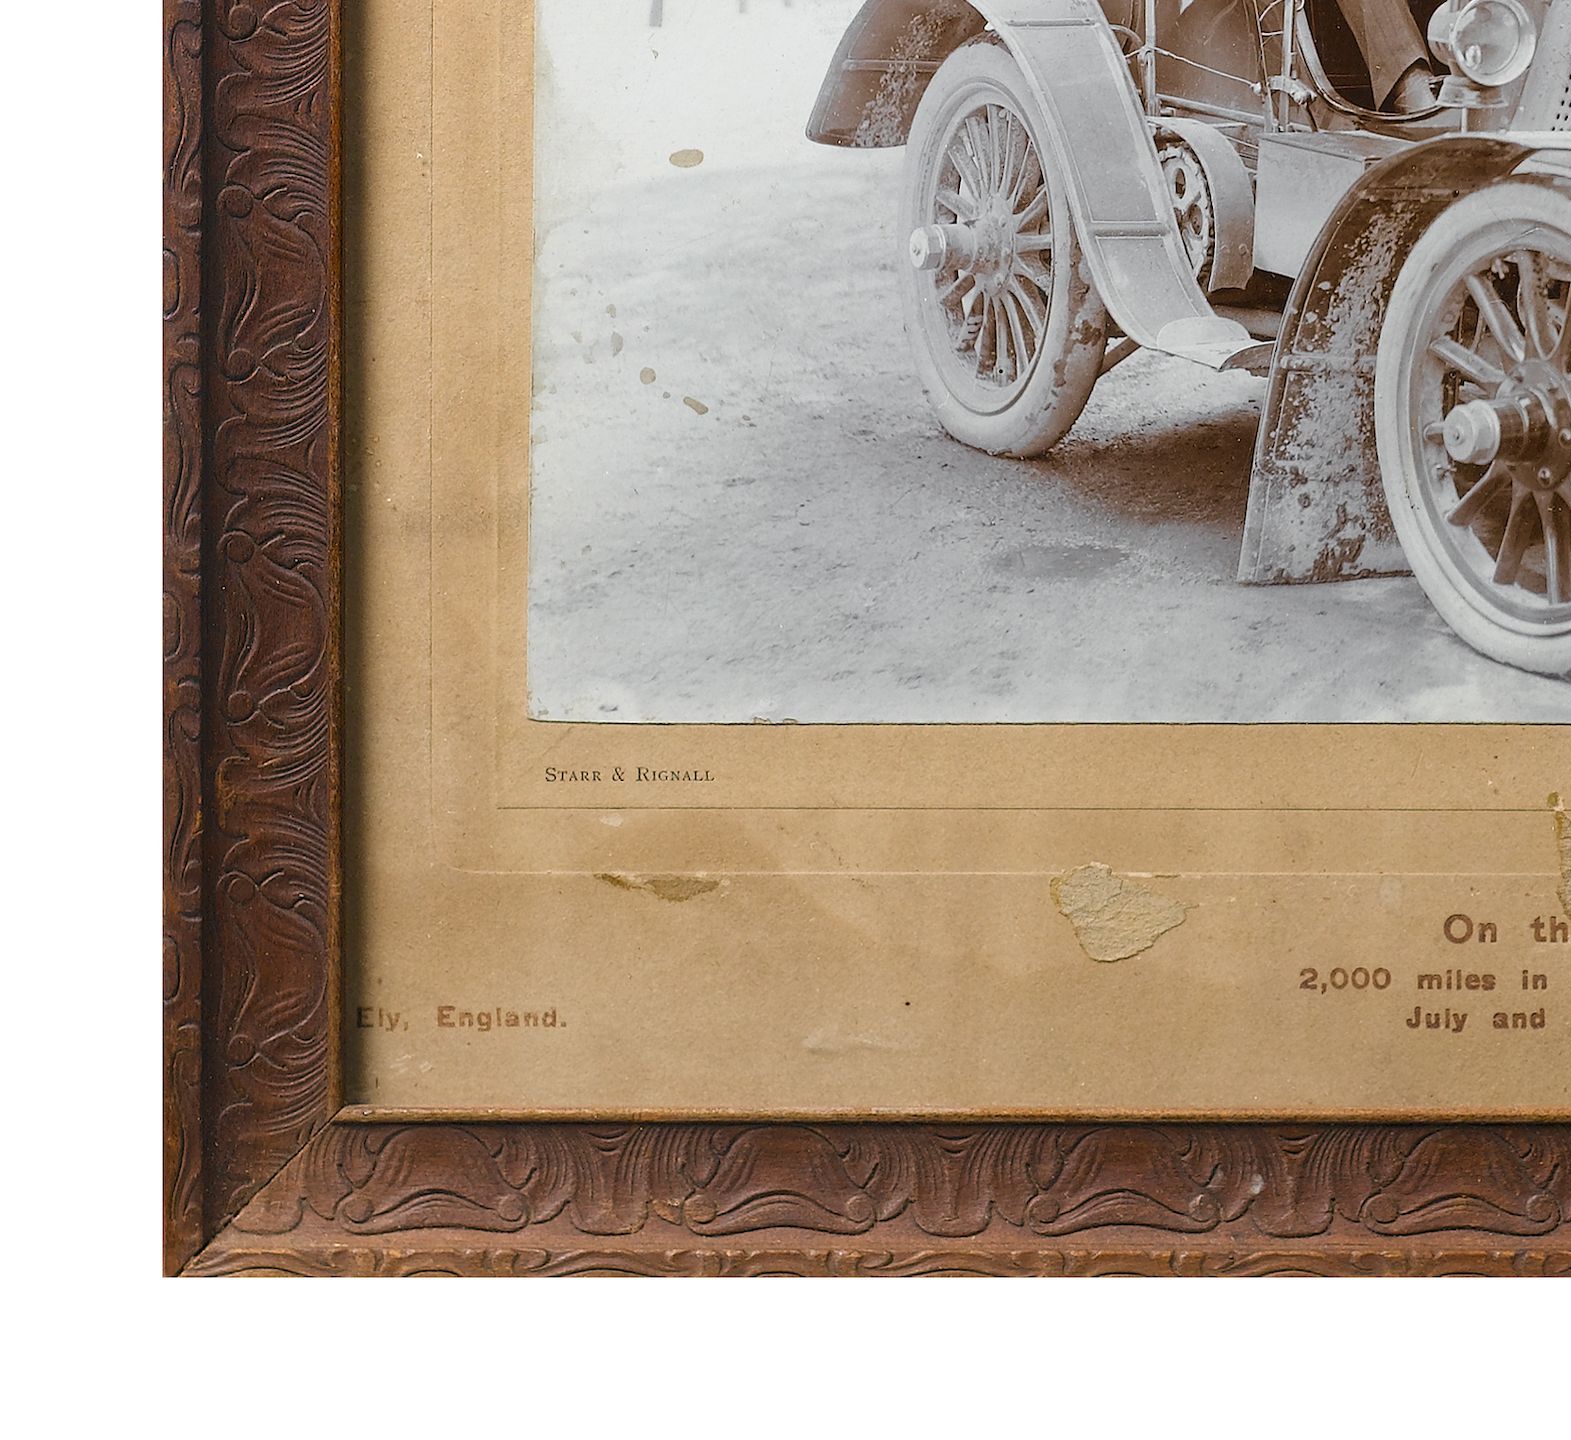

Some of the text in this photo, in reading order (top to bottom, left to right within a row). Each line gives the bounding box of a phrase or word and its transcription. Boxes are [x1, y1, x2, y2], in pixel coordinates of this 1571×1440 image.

[545, 766, 716, 783] STARR & RIGNALL
[1443, 913, 1498, 945] On
[1299, 966, 1392, 995] 2,000
[1417, 968, 1497, 992] miles
[1521, 968, 1548, 992] in
[356, 1005, 568, 1033] Ely, England.
[1406, 1006, 1468, 1033] July
[1492, 1007, 1547, 1030] and
